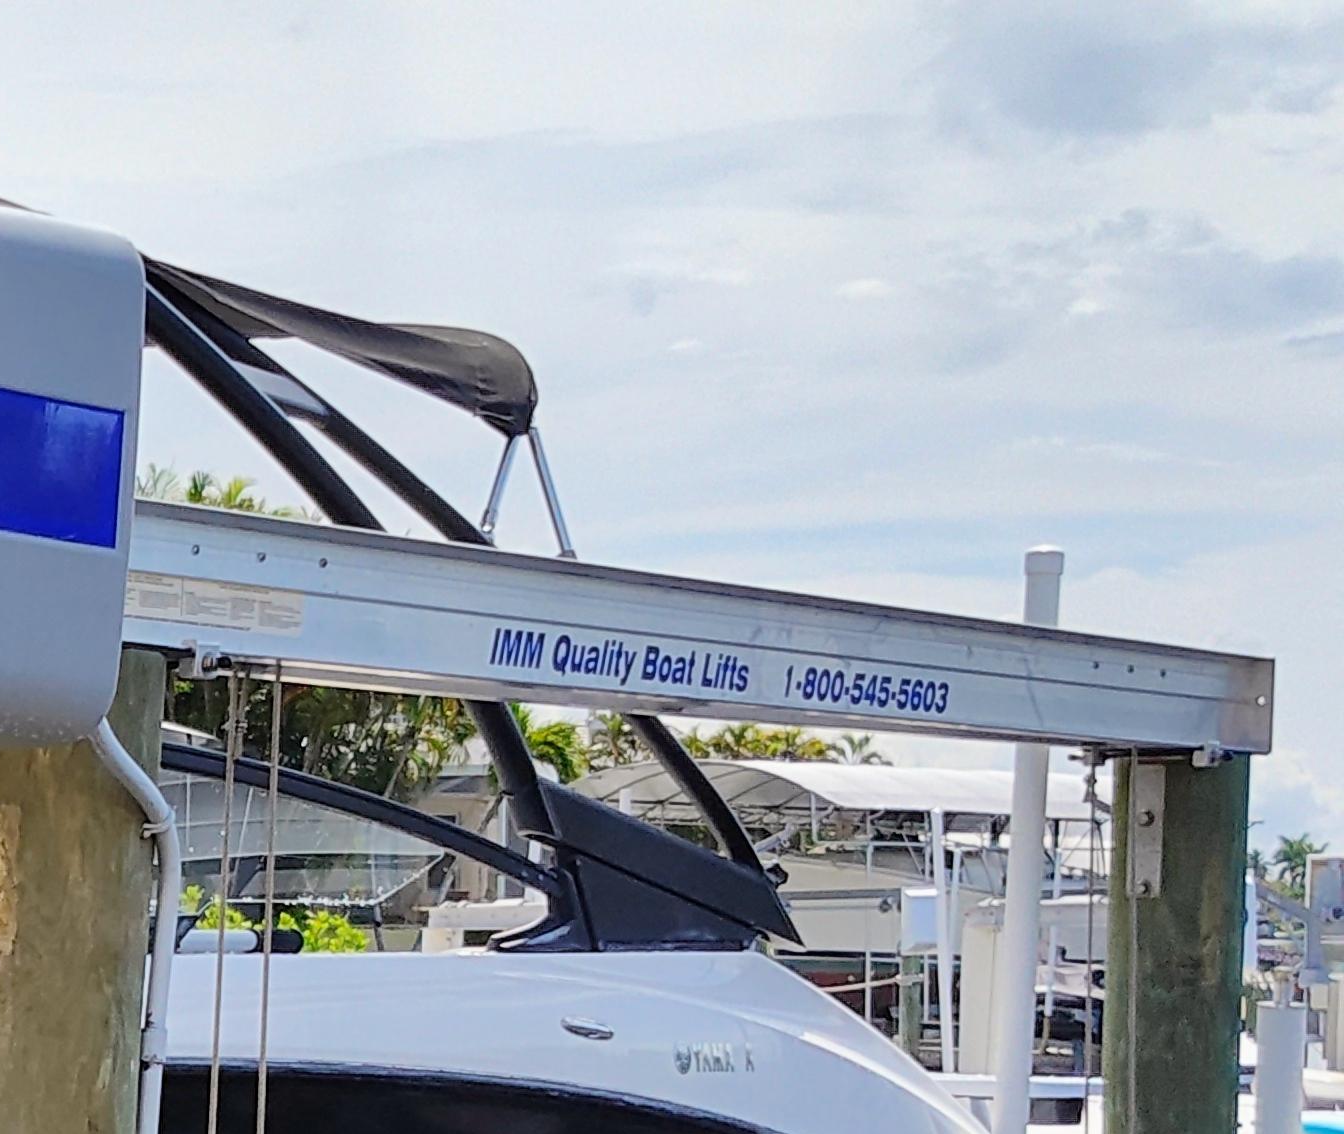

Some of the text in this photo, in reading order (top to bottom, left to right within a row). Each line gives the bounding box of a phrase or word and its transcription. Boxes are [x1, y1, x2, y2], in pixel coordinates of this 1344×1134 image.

[489, 627, 950, 714] IMM Quality Boat Lifts 1-800-545-5603
[692, 1042, 755, 1073] YAMAA
